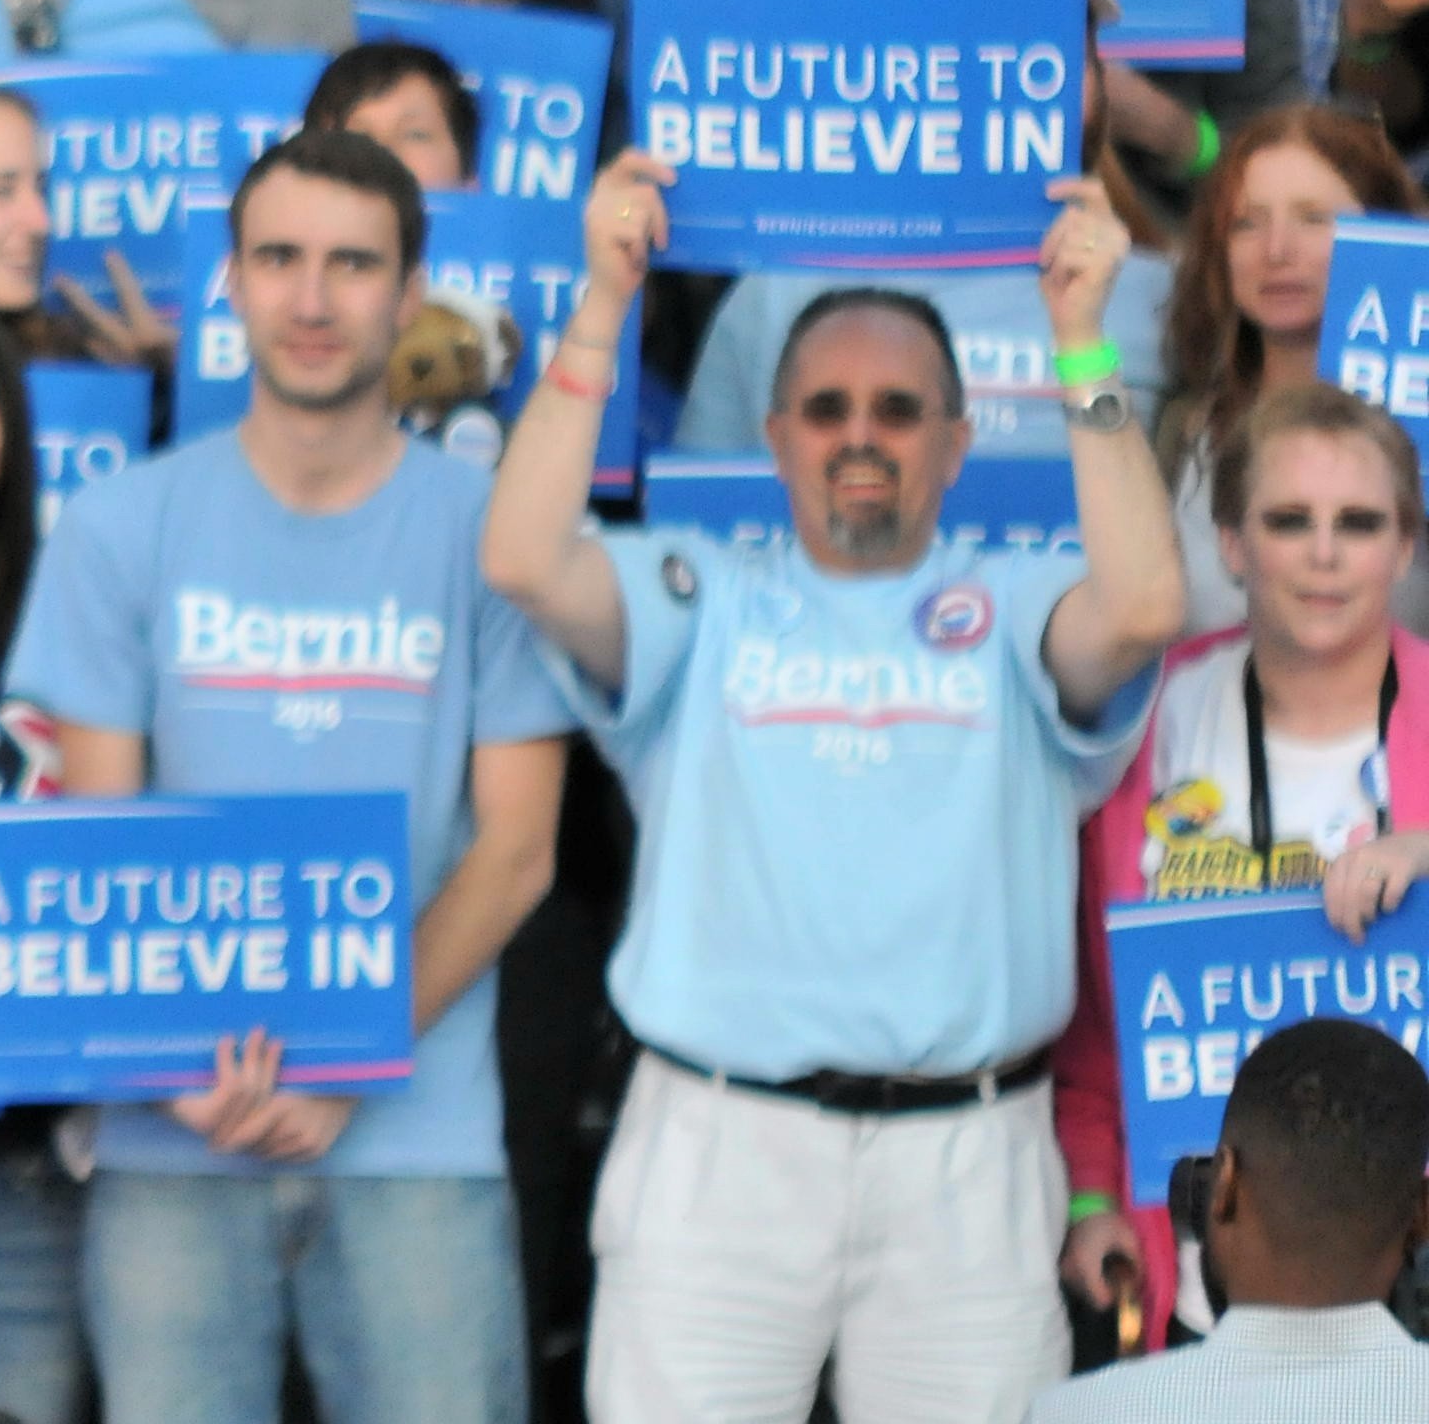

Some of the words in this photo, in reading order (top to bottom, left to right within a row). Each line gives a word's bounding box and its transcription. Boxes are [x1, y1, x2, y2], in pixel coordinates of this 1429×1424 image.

[651, 37, 690, 96] A
[705, 38, 962, 103] FUTURE
[978, 42, 1067, 103] TO
[495, 76, 584, 139] TO
[647, 102, 963, 175] BELIEVE
[982, 107, 1065, 176] IN
[44, 115, 223, 174] TURE
[492, 137, 578, 201] IN
[1345, 284, 1390, 346] A
[37, 430, 128, 482] TO
[175, 587, 444, 681] Bernie
[725, 637, 990, 714] Bernie
[25, 863, 286, 925] FUTURE
[300, 858, 395, 919] TO
[308, 923, 396, 991] IN
[1142, 971, 1186, 1031] A
[1200, 951, 1429, 1025] FUTUR
